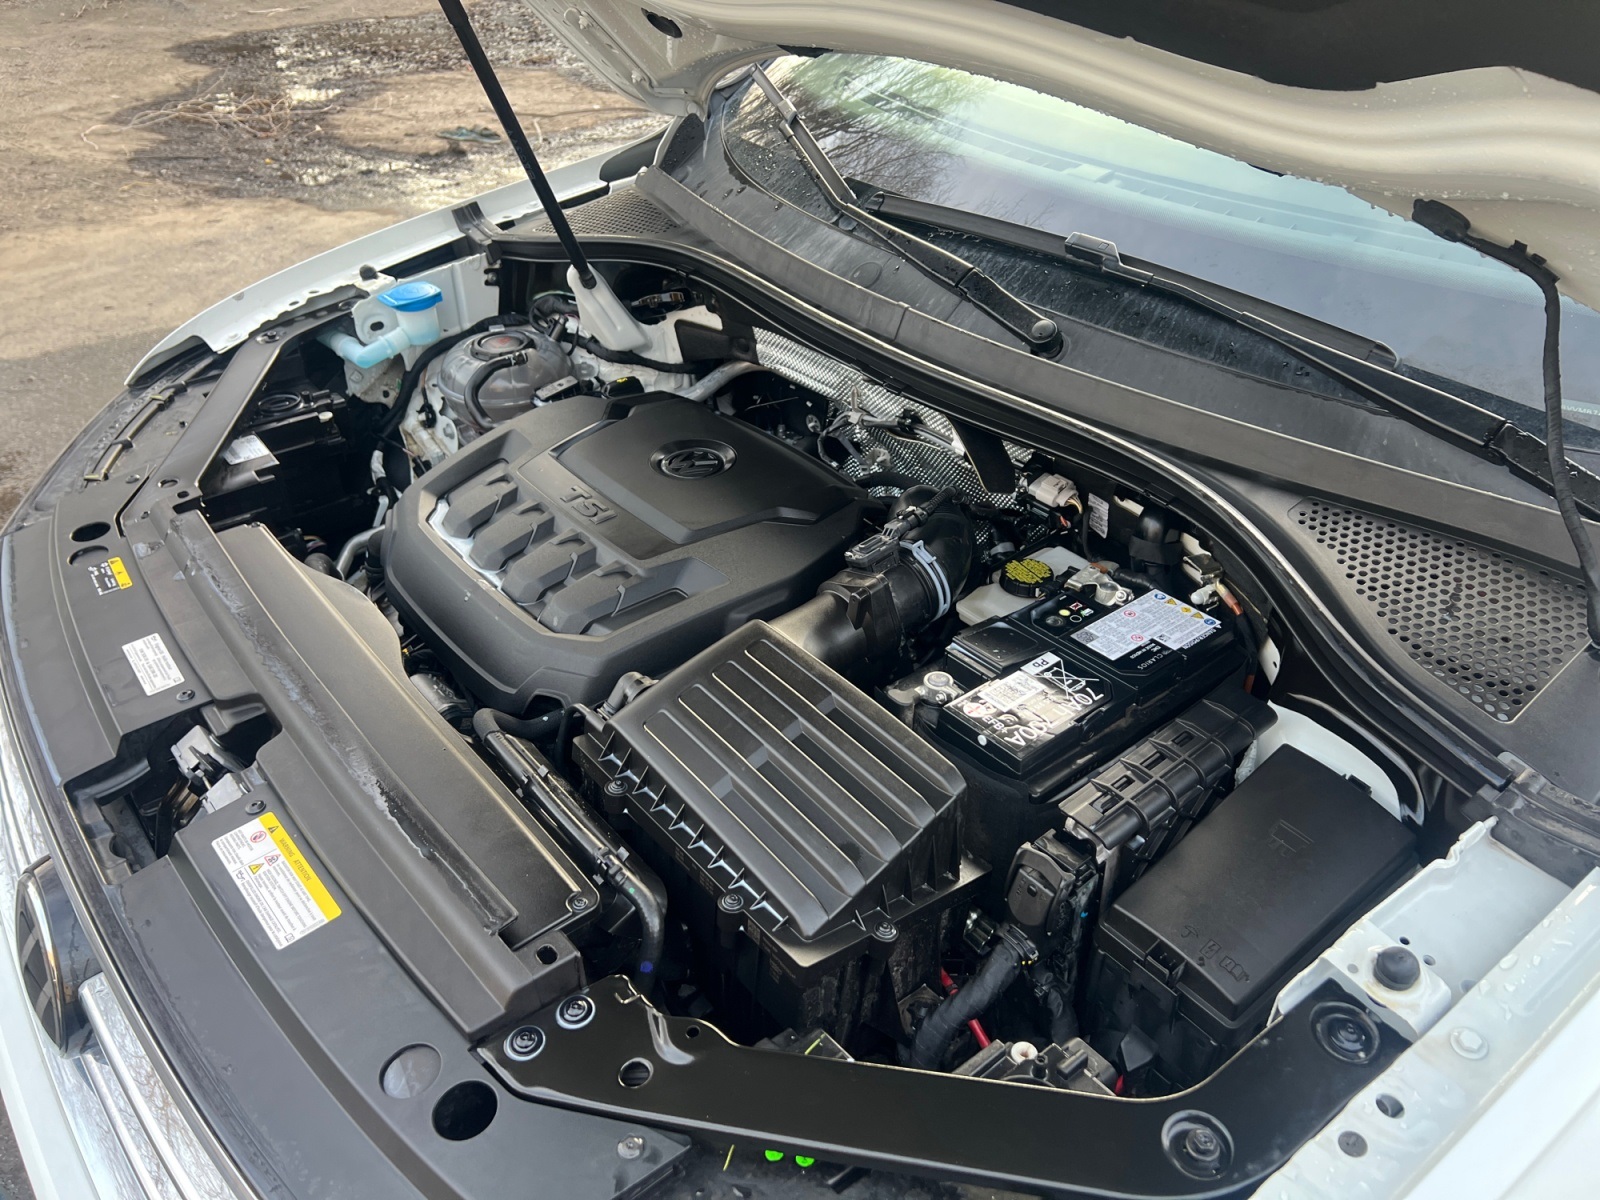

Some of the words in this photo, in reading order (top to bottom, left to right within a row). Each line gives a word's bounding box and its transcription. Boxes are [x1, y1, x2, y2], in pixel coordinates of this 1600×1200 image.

[560, 485, 618, 525] TSI
[1032, 658, 1050, 668] Pb
[1137, 653, 1164, 670] CLARIOS
[1052, 687, 1105, 716] 70Ah
[279, 838, 295, 858] WARNING
[293, 859, 312, 882] ATTENTION
